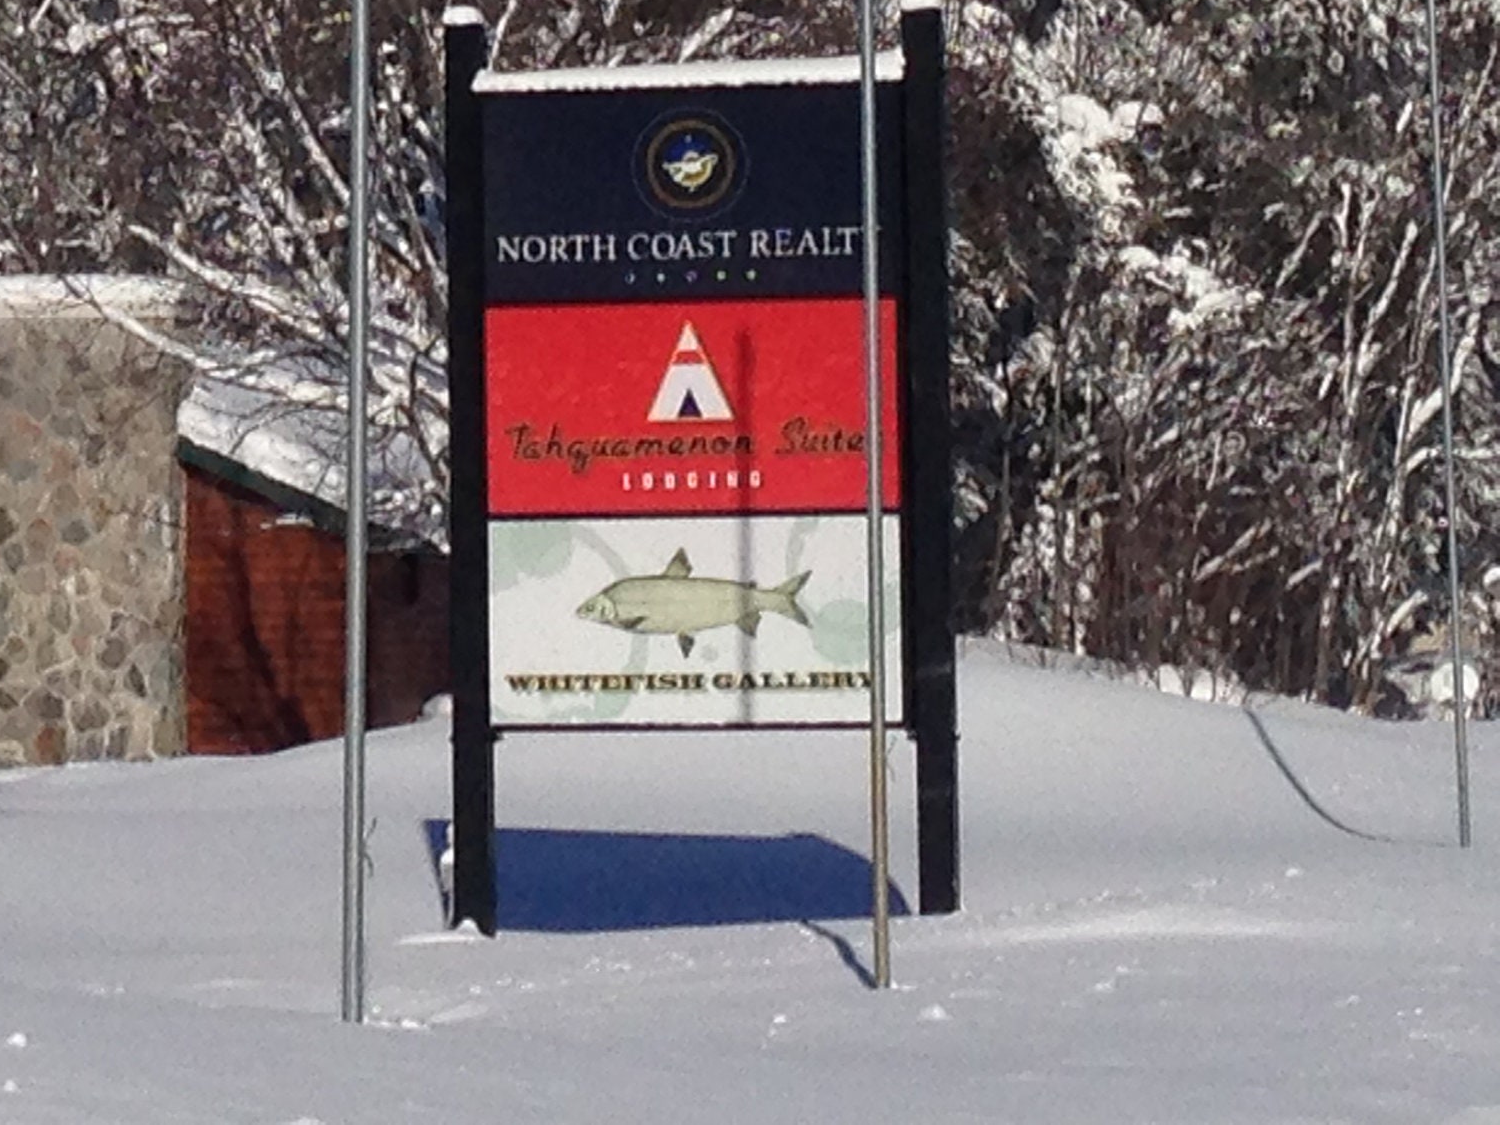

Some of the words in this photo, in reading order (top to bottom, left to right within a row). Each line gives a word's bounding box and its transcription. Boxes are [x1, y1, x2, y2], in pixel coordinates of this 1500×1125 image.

[496, 231, 617, 264] NORTH
[626, 229, 737, 260] COAST
[749, 225, 882, 258] REALT
[774, 415, 882, 455] Suite
[622, 470, 763, 491] LODGING
[504, 671, 706, 693] WHITEFISH
